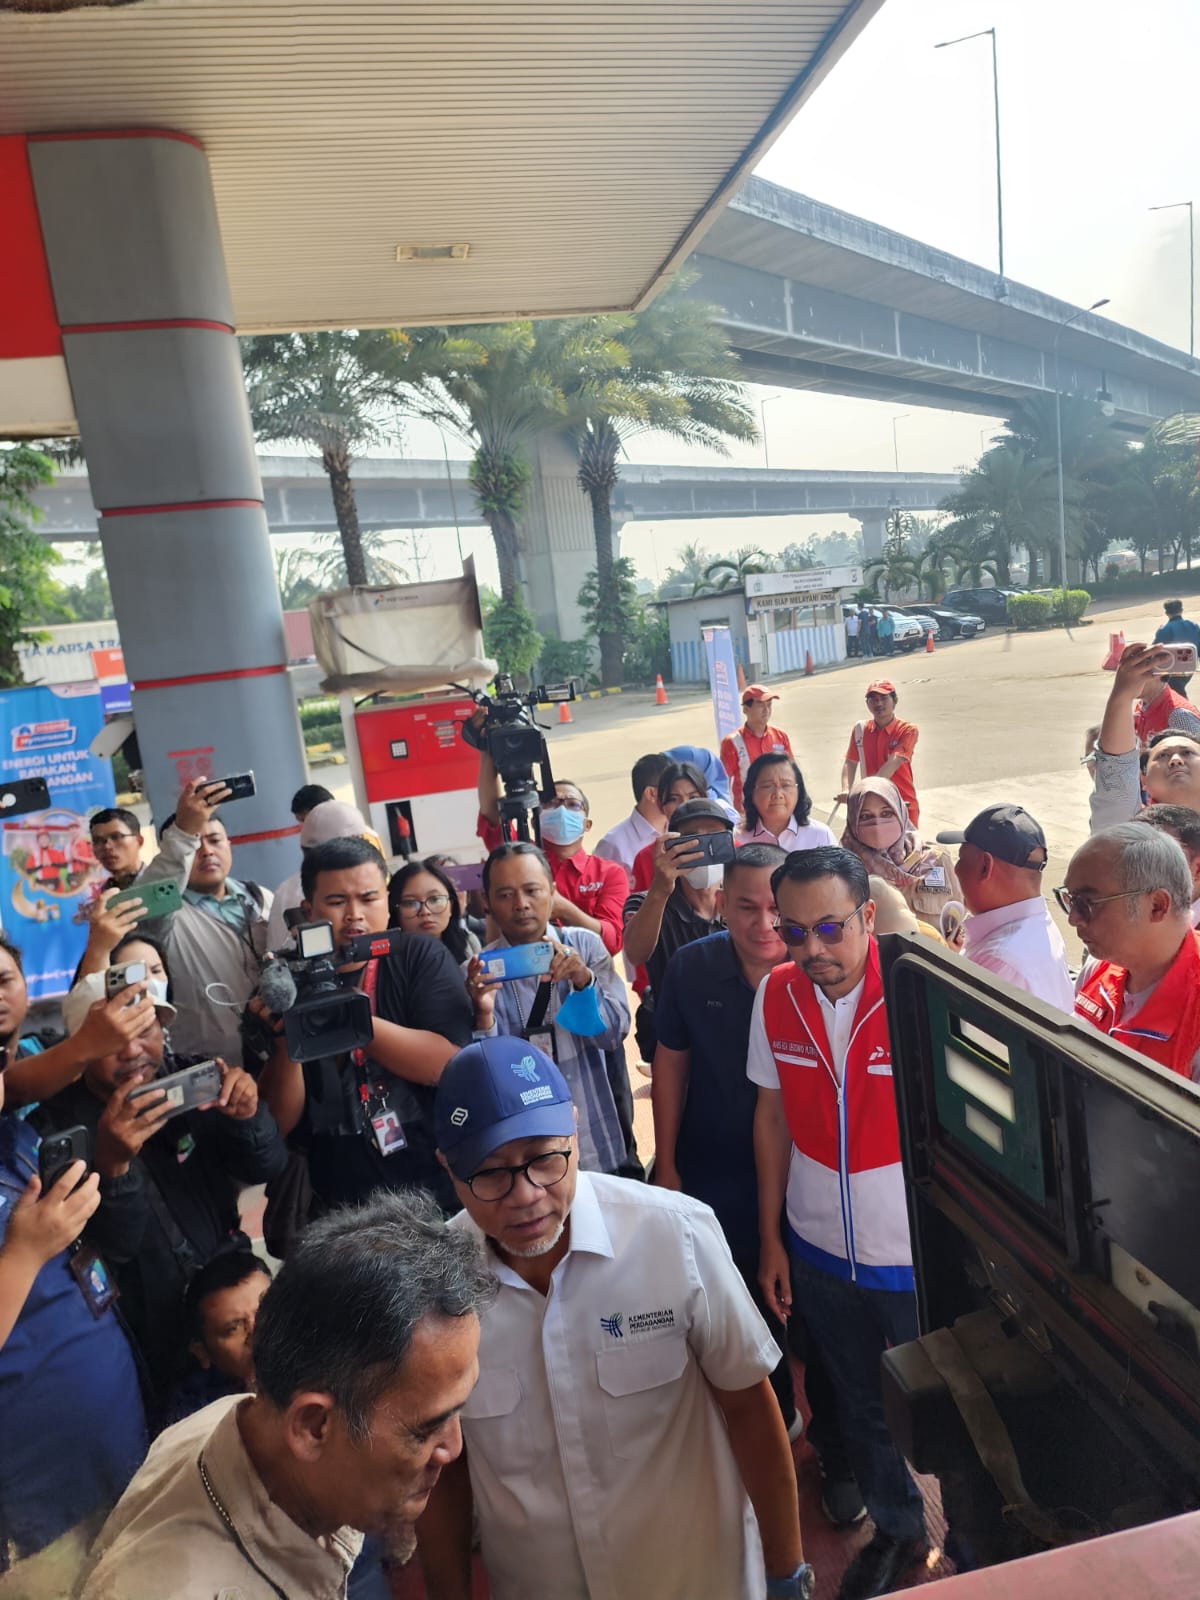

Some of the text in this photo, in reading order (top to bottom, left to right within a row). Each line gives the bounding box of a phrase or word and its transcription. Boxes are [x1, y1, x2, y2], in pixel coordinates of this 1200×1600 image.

[47, 750, 89, 764] UNTUK
[628, 1309, 674, 1323] KEMENTERIAN
[629, 1316, 675, 1330] PERDAGANGAN
